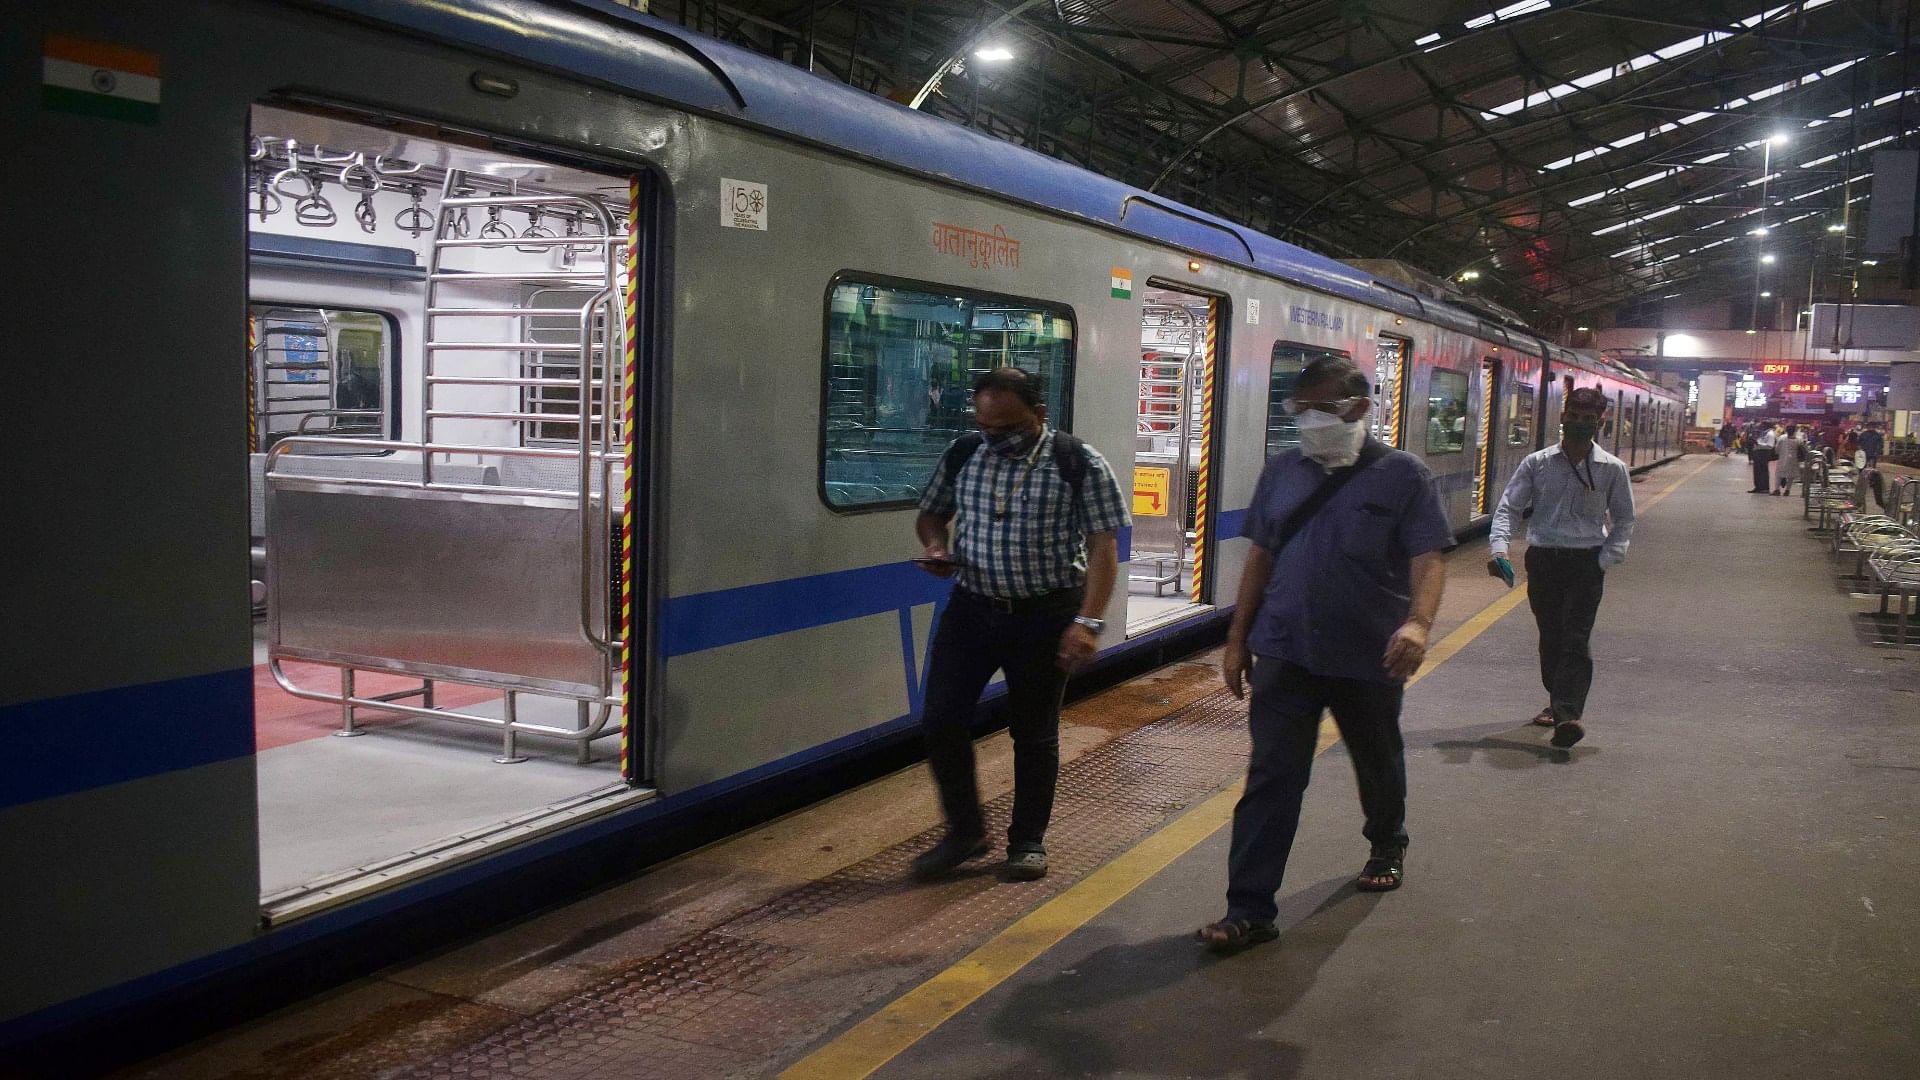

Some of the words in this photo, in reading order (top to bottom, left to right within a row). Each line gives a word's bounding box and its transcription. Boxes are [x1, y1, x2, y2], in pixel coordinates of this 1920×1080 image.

[932, 222, 1020, 271] वातानुकूलित
[1290, 304, 1319, 327] WESTERN
[1319, 312, 1344, 332] RAILWAY
[1763, 364, 1790, 374] 05:47
